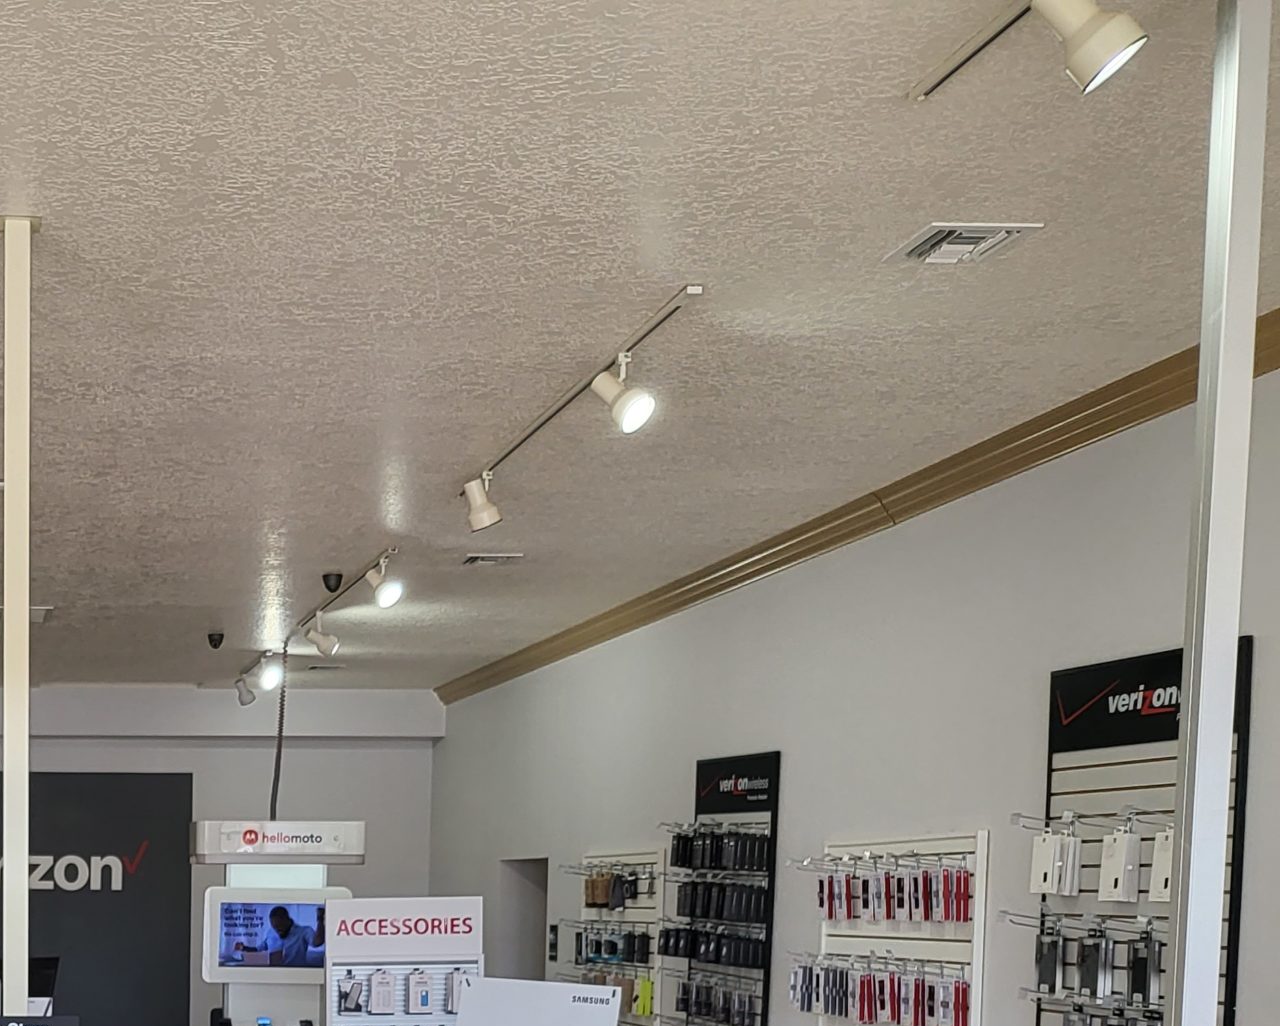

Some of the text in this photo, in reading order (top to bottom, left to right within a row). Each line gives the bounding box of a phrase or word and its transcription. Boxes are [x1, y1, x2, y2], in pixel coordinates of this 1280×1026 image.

[262, 832, 323, 844] hellomoto
[336, 917, 473, 936] ACCESSORIES
[572, 995, 610, 1005] SAMSUNG
